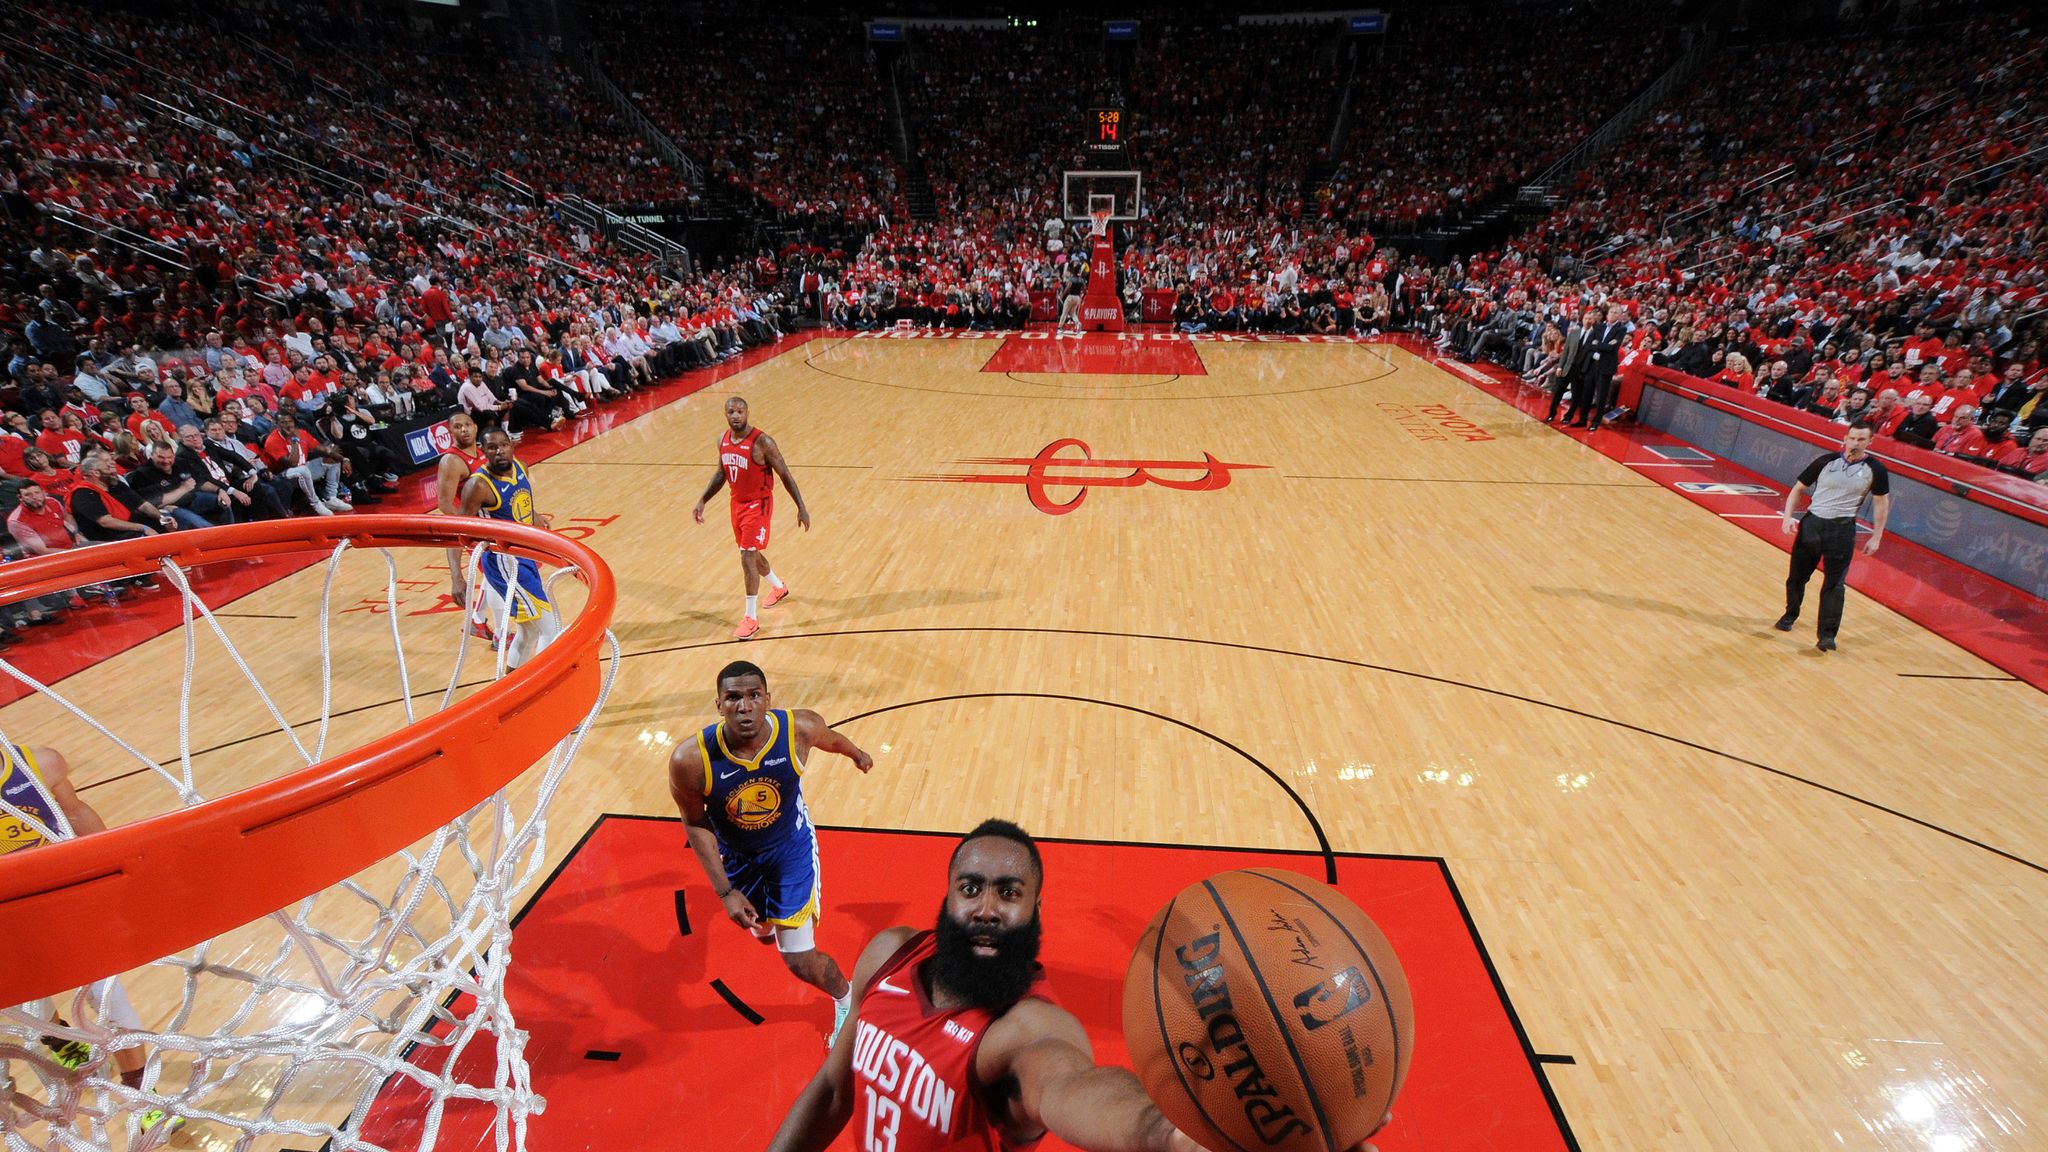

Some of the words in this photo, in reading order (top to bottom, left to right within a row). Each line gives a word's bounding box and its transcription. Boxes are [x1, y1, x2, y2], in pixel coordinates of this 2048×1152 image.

[1099, 111, 1119, 123] 5:28
[1101, 124, 1117, 140] 14
[637, 215, 664, 223] TUNNEL
[1089, 308, 1118, 320] PLAYOFFS
[853, 331, 1087, 340] HOUSTON
[1119, 332, 1356, 343] ROCKETS
[1415, 404, 1496, 442] TOYOTA
[411, 435, 431, 457] NBA
[437, 432, 451, 444] TNT
[721, 453, 748, 470] HOUSTON
[728, 465, 739, 483] 17
[759, 777, 781, 790] STATE
[757, 790, 767, 802] 5
[1175, 931, 1314, 1146] SPALDING
[852, 1018, 956, 1135] HOUSTON
[865, 1084, 901, 1152] 13
